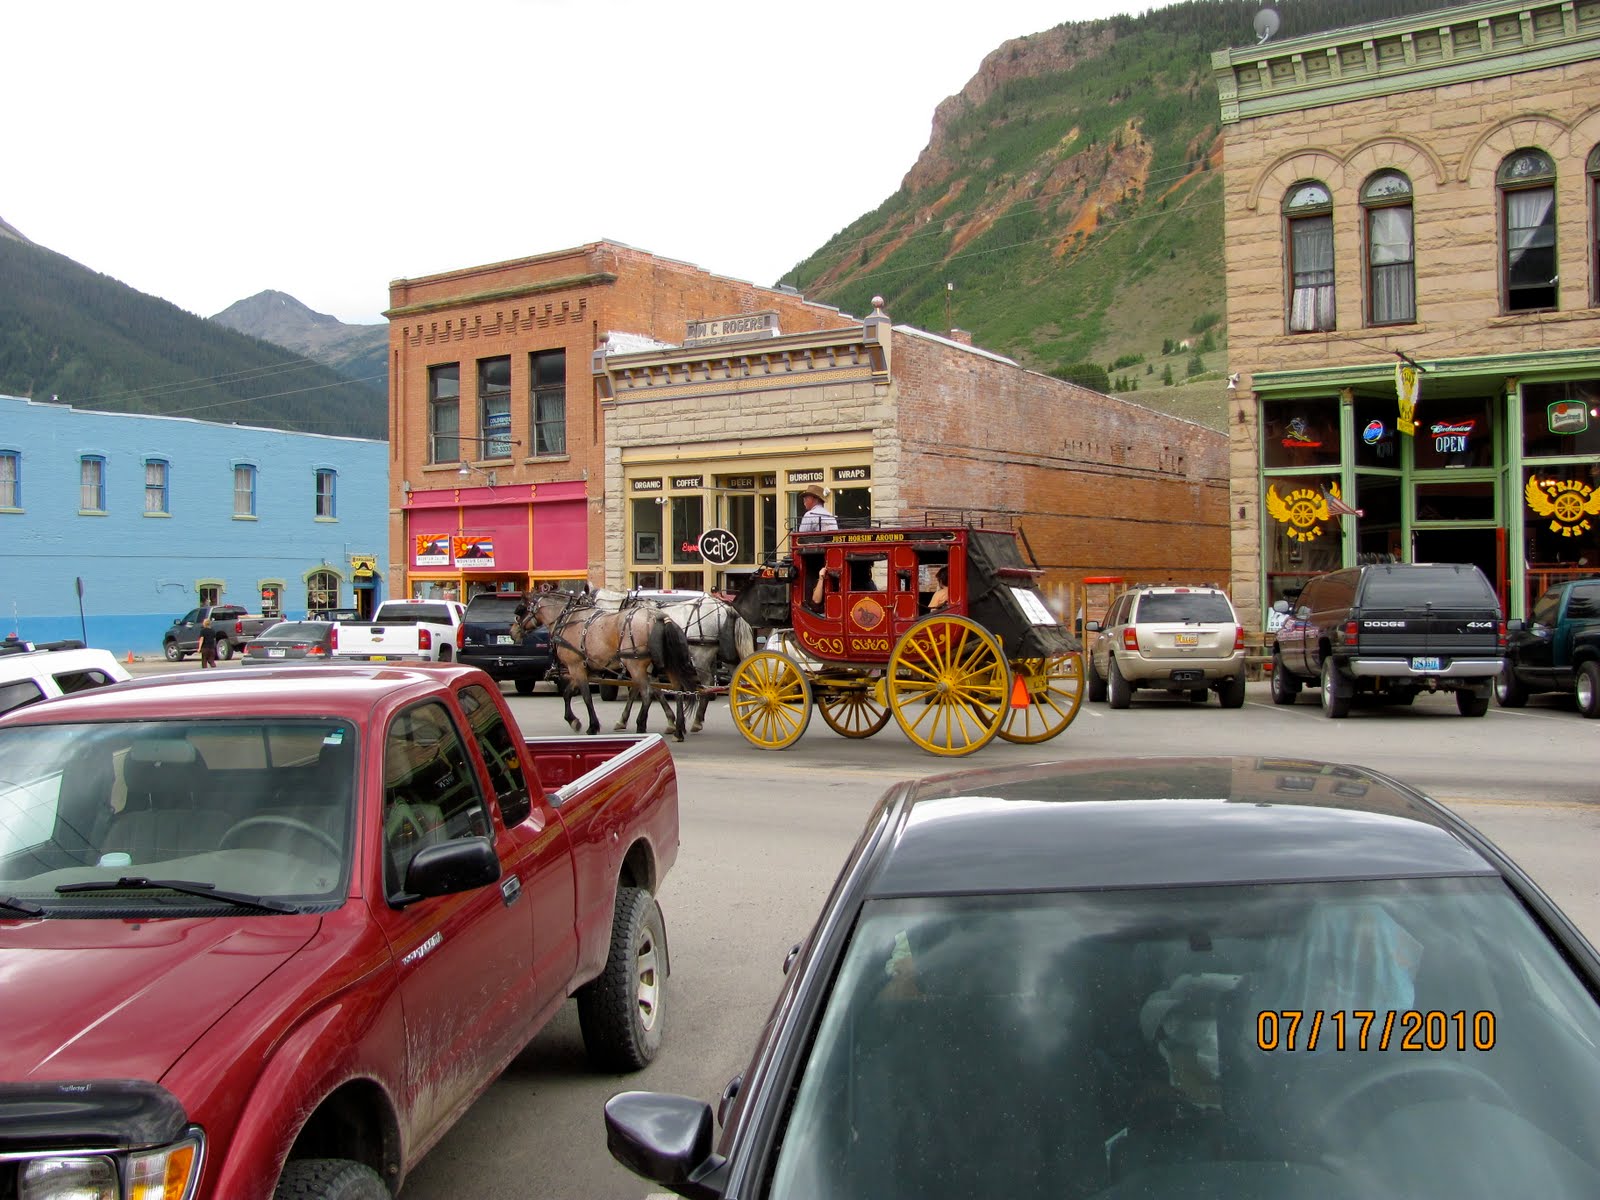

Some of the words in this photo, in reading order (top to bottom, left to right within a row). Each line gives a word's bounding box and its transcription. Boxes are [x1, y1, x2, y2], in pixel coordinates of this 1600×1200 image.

[711, 322, 718, 336] C
[723, 317, 763, 334] ROGERS
[1435, 436, 1466, 453] OPEN
[789, 472, 824, 482] BURRITOS
[838, 469, 865, 479] WRAPS
[634, 480, 661, 489] ORGANIC
[676, 478, 699, 488] COFFEE
[730, 477, 753, 487] BEER
[764, 476, 777, 485] WI
[1547, 479, 1592, 498] PRIDE
[1284, 488, 1323, 506] PRIDE
[1549, 519, 1591, 537] WEST
[832, 535, 847, 543] JUST
[848, 534, 873, 542] HORSIN'
[875, 533, 905, 541] AROUND
[1287, 525, 1322, 542] WEST
